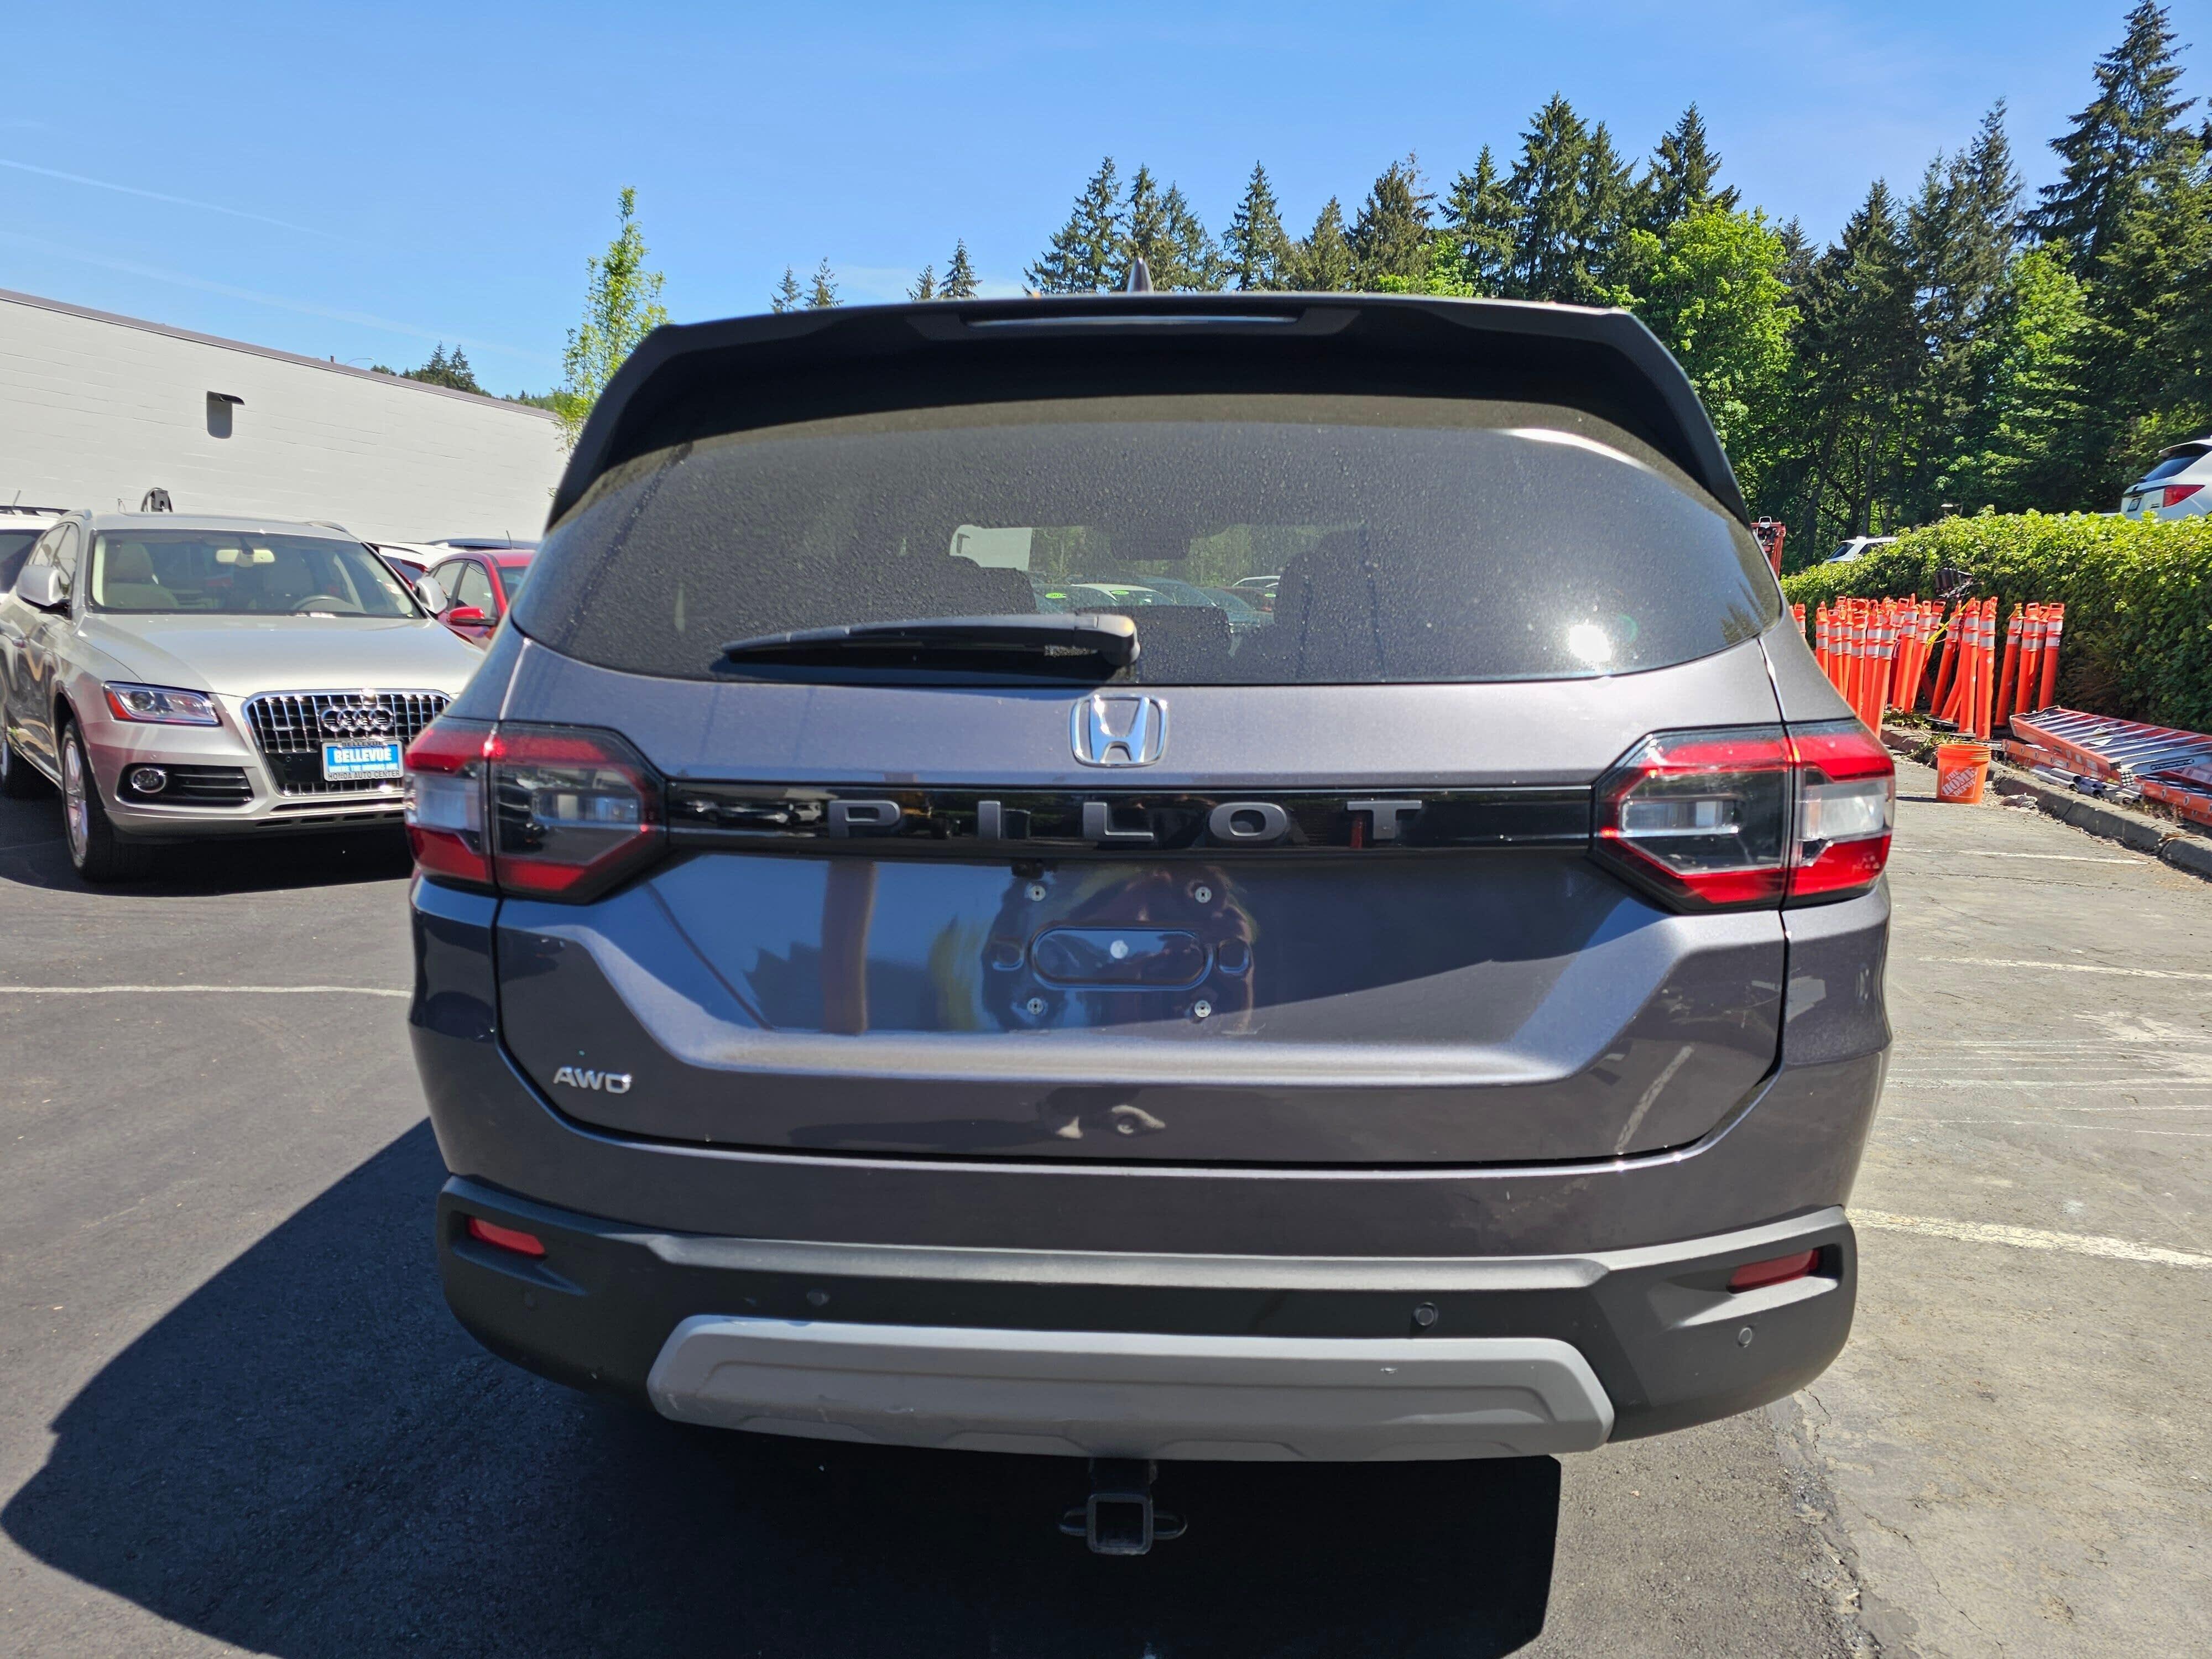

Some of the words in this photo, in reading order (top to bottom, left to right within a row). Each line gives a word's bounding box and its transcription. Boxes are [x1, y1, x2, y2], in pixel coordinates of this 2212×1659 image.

[333, 748, 392, 763] BELLEVUE
[1942, 767, 1976, 795] HOME
[1945, 770, 1960, 780] THE
[1953, 780, 1975, 796] DEPOT
[828, 799, 1422, 842] PILOT
[553, 1066, 632, 1093] AWD
